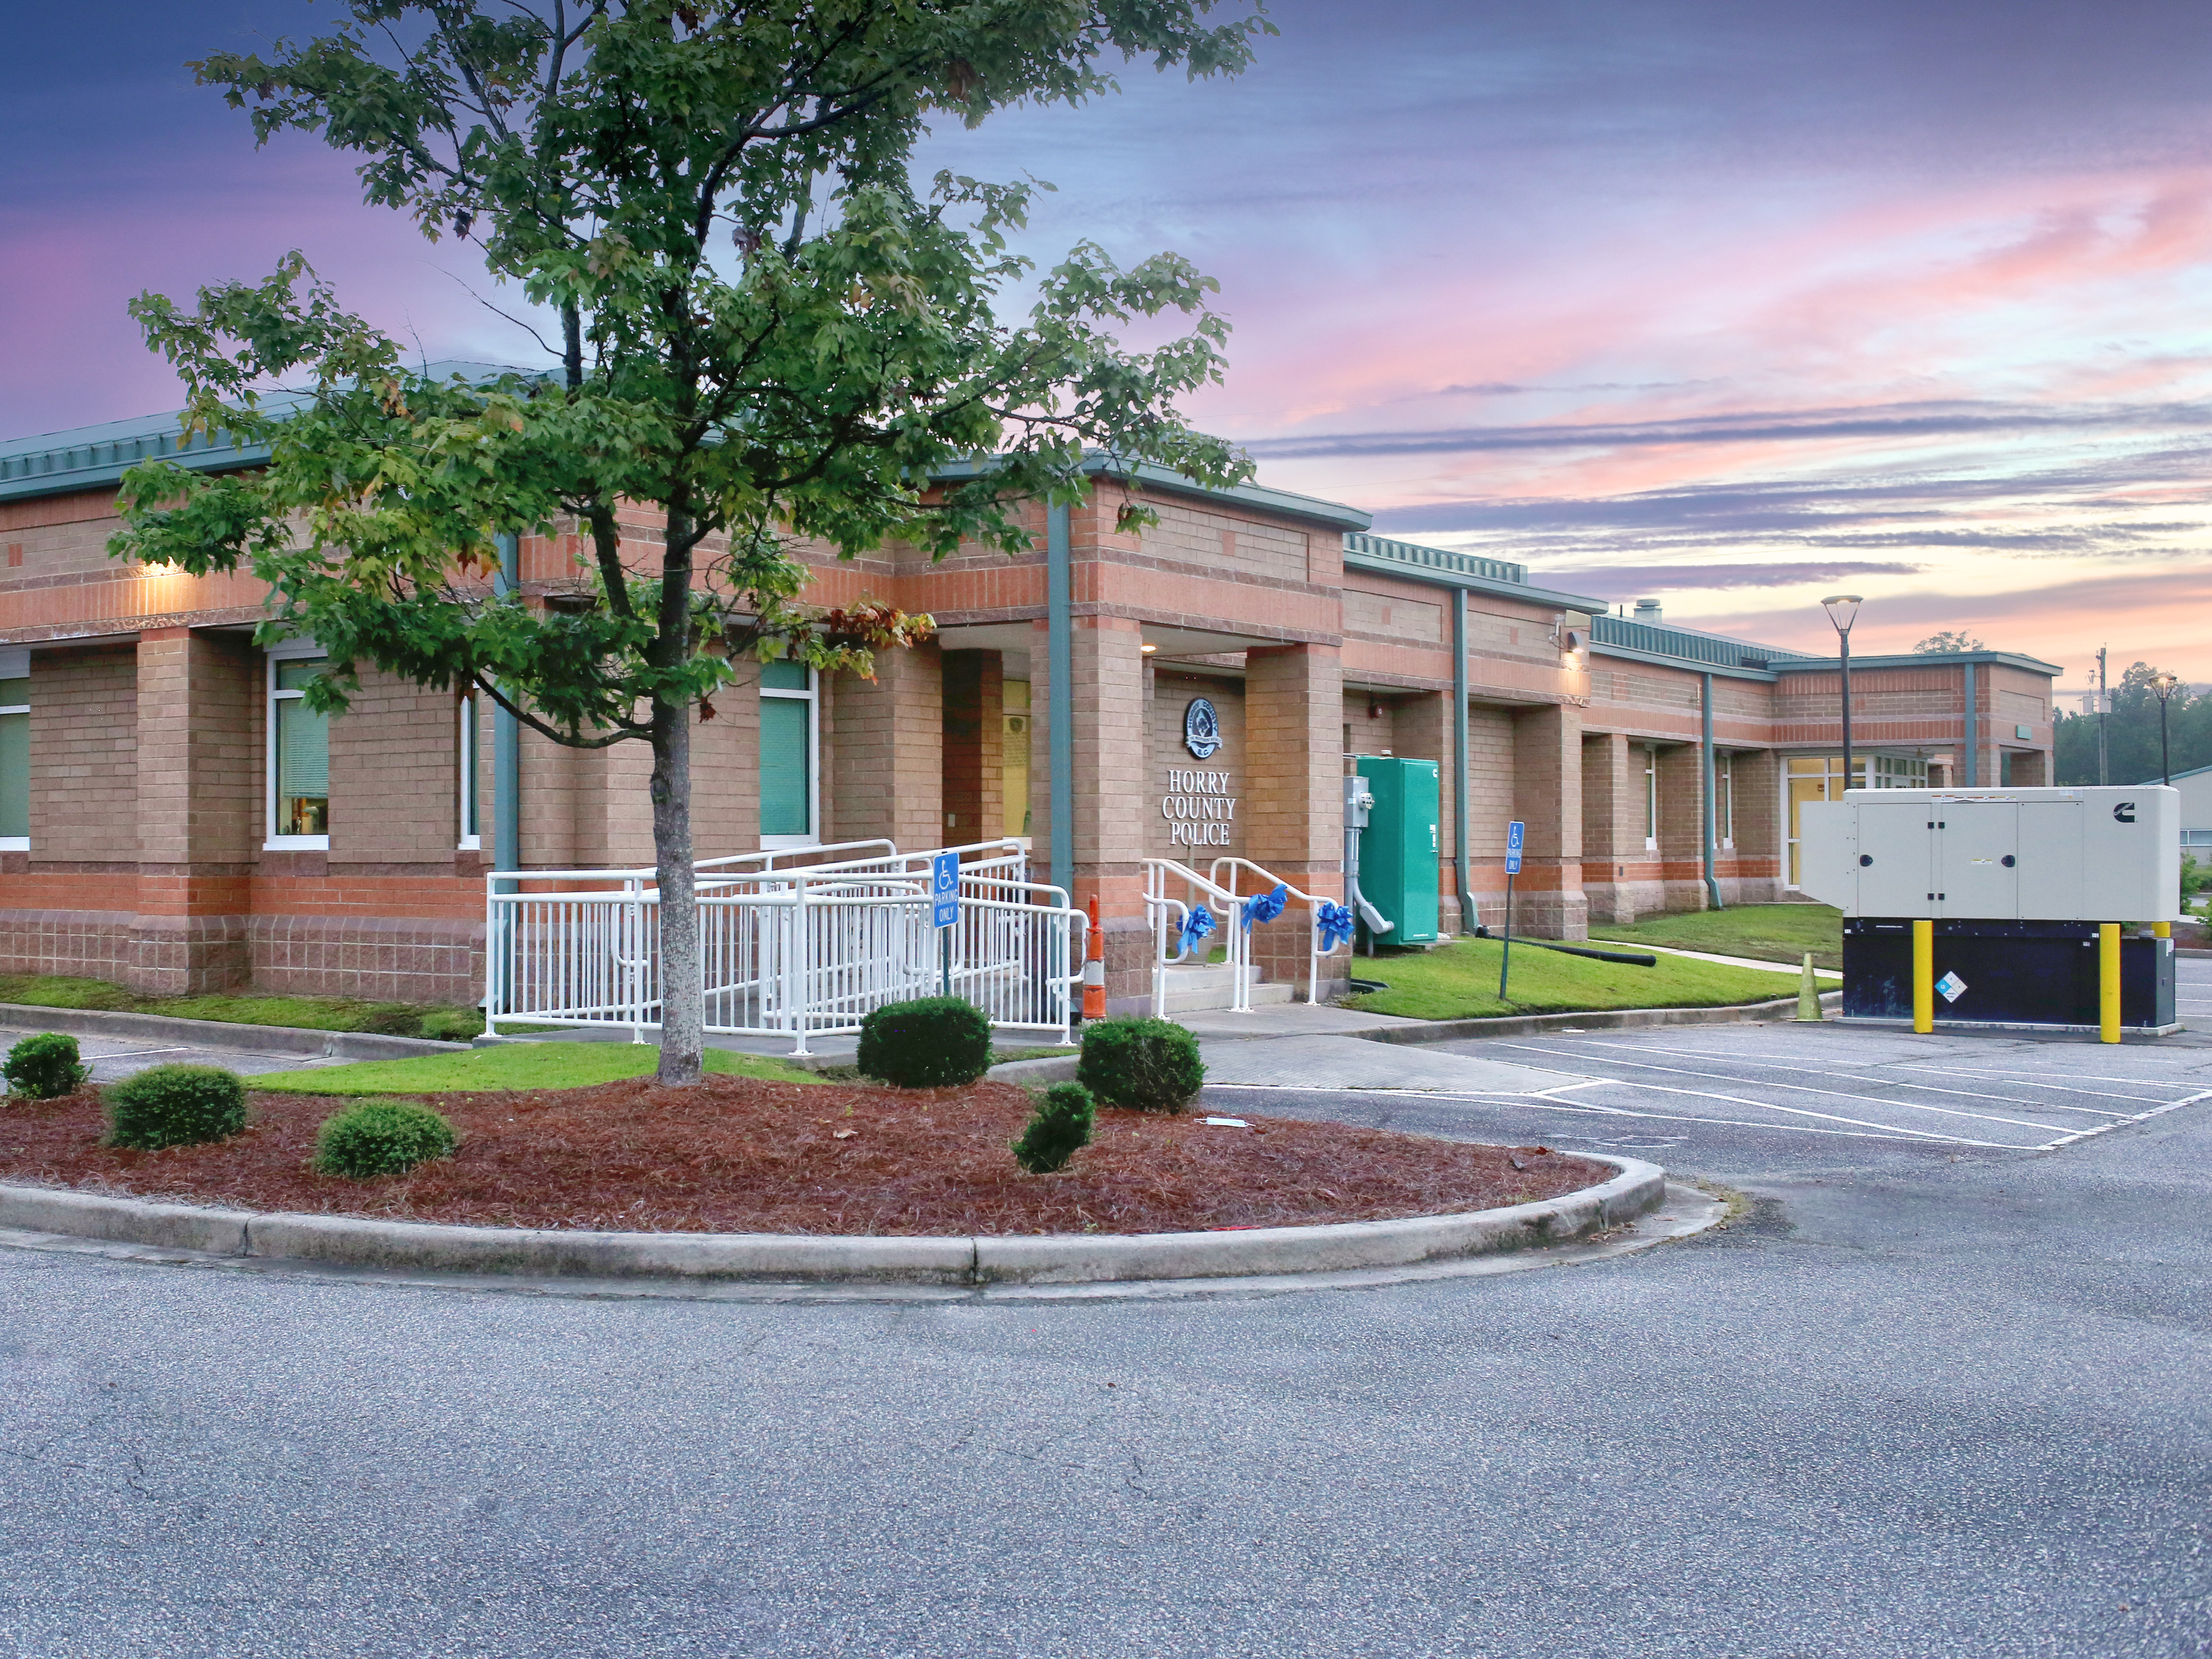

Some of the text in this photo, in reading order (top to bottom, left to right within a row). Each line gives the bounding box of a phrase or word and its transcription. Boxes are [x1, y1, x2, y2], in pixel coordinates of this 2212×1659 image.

[1169, 770, 1230, 794] HORRY
[1163, 796, 1236, 820] COUNTY
[1170, 822, 1230, 846] POLICE
[935, 889, 958, 907] PARKING
[939, 906, 954, 922] ONLY
